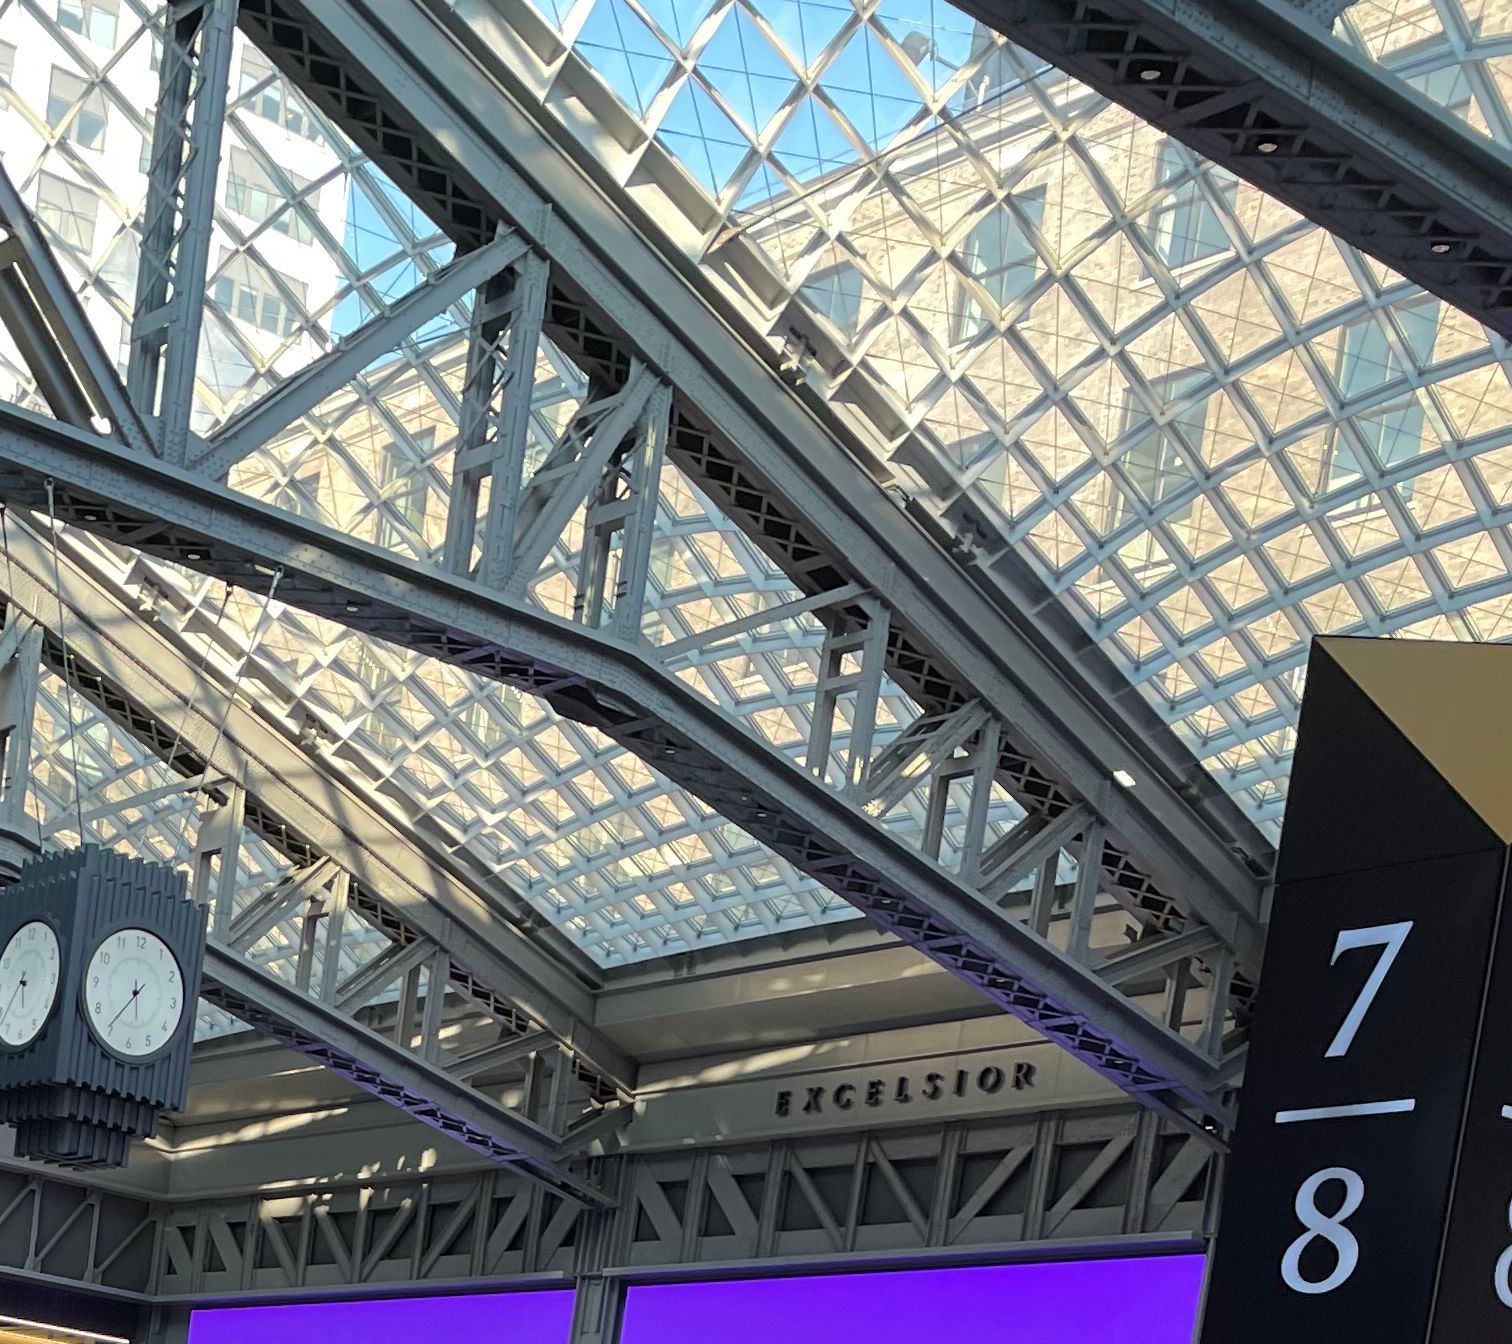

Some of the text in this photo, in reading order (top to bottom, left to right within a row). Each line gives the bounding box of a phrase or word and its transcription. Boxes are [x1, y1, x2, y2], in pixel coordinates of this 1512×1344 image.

[1323, 919, 1415, 1059] 7
[775, 1061, 1037, 1117] EXCELSIOR
[1280, 1166, 1365, 1295] 8
